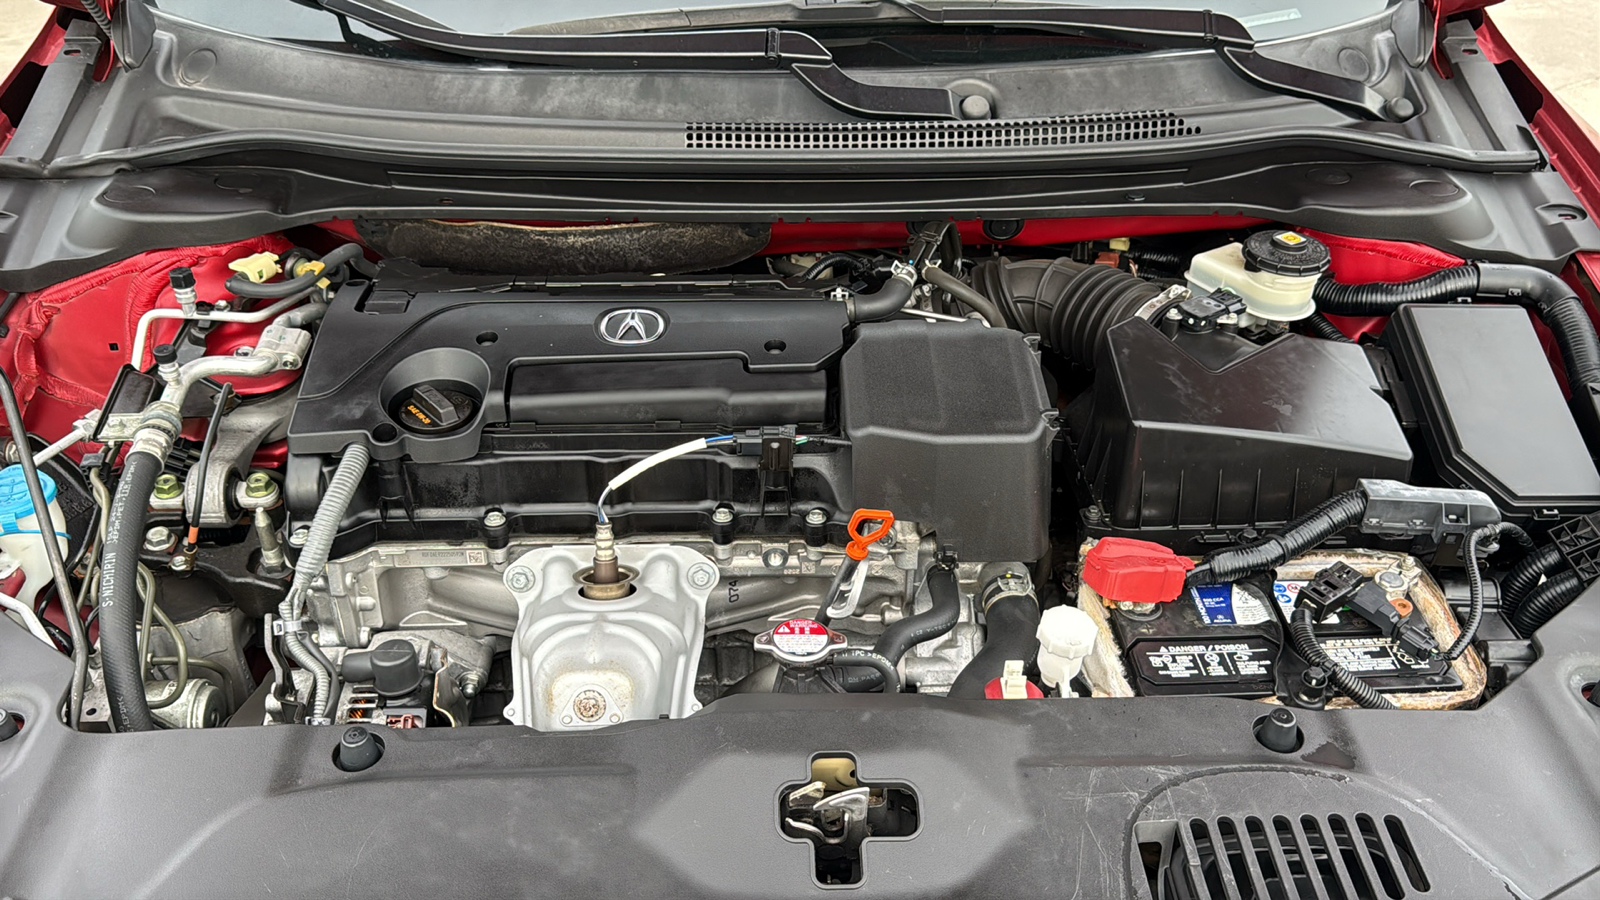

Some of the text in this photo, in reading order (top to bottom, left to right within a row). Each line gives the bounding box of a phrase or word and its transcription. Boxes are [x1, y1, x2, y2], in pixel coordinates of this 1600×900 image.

[728, 580, 740, 604] 074
[1168, 645, 1207, 653] DANGER
[1213, 643, 1249, 652] POISON
